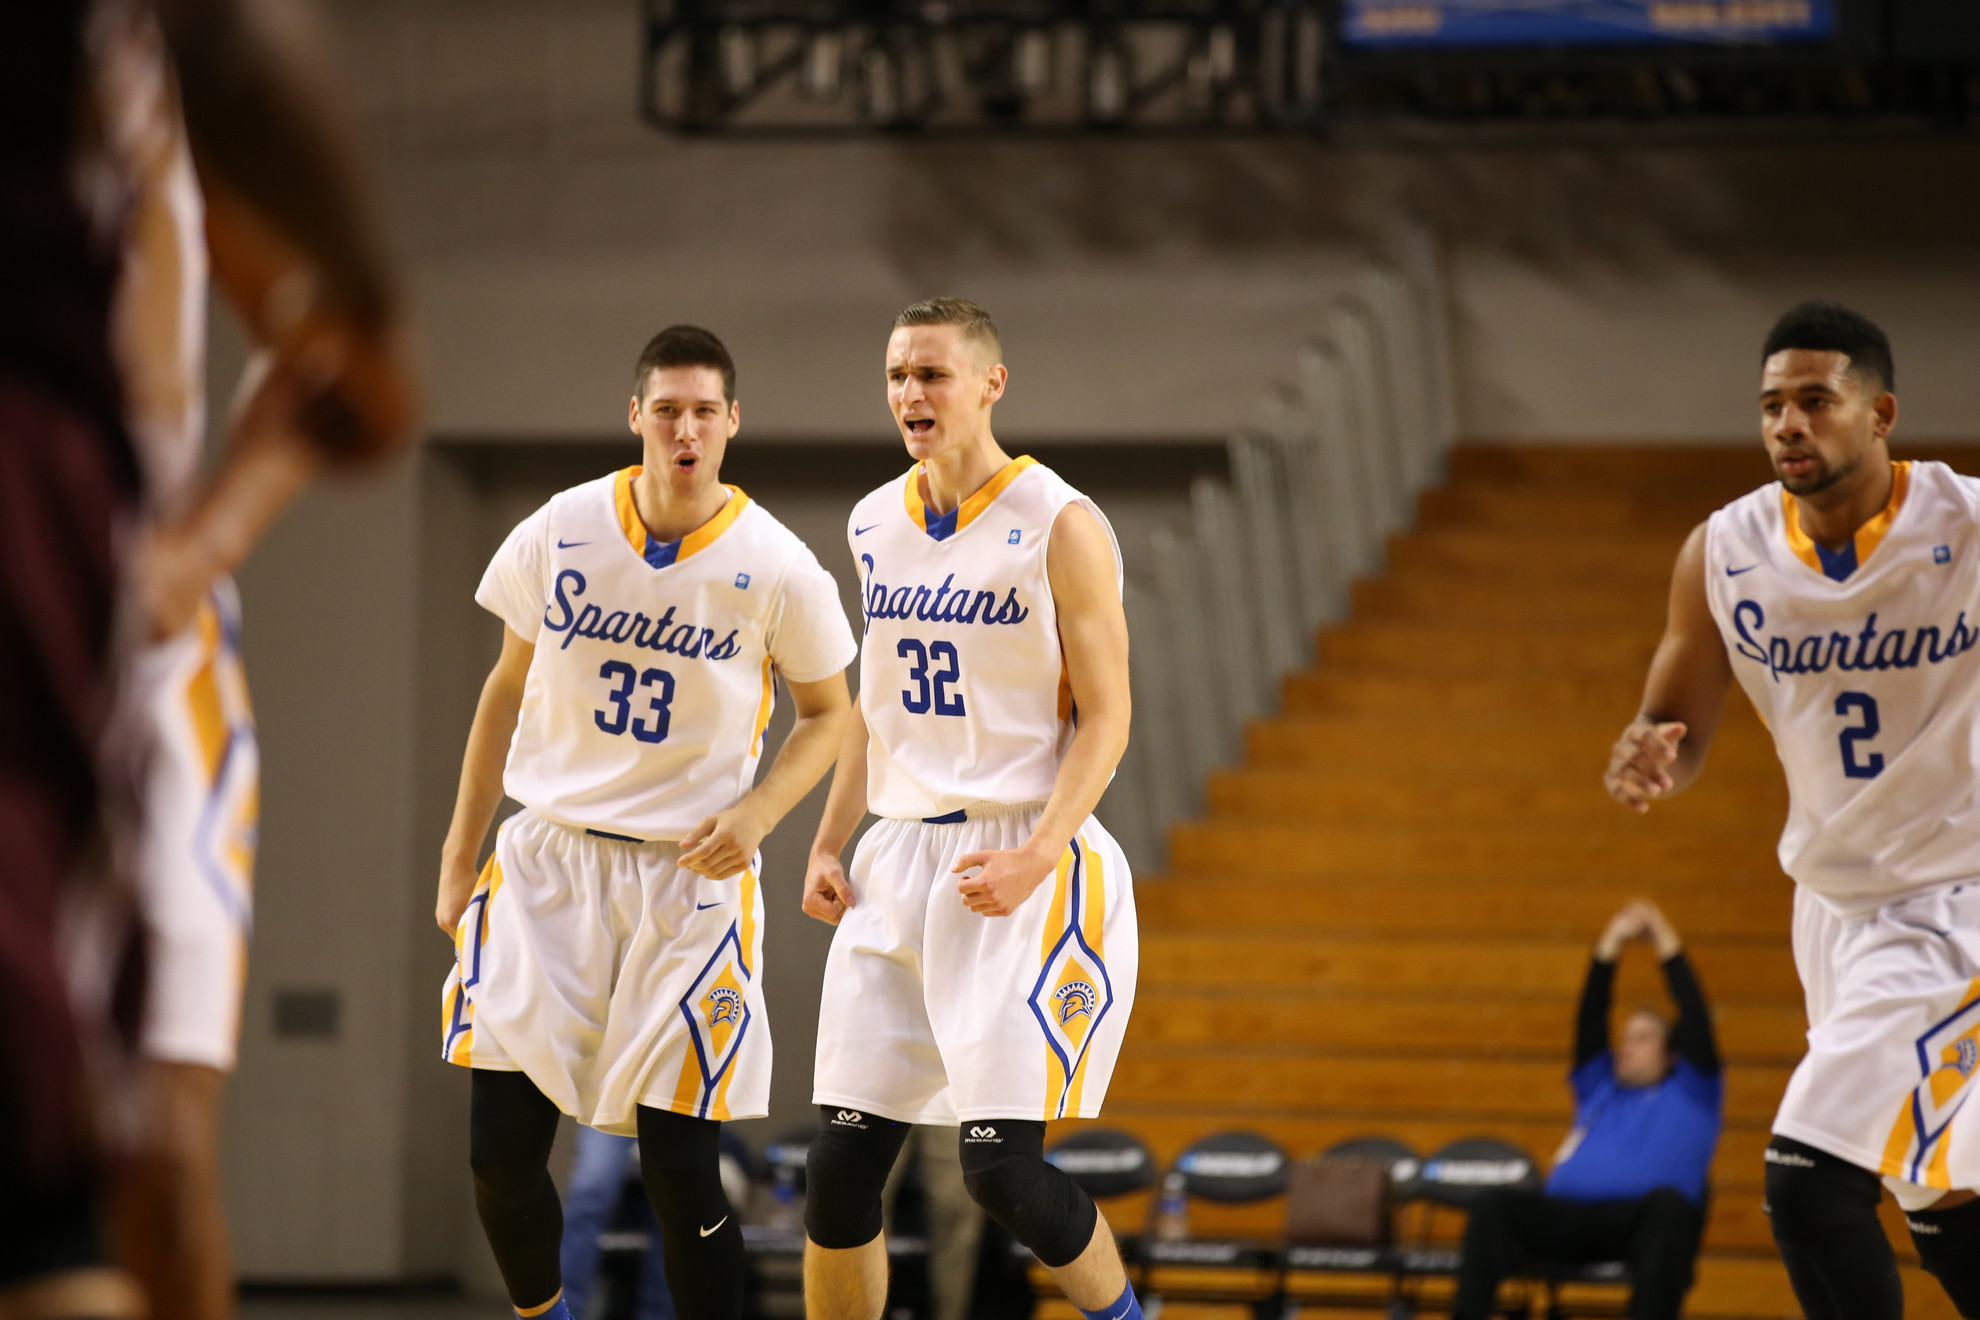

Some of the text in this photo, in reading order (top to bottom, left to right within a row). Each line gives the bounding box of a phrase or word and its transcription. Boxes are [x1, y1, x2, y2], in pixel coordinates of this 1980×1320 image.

[544, 568, 739, 661] Spartans
[1733, 599, 1979, 683] Spartans
[594, 660, 675, 744] 33
[897, 638, 966, 717] 32
[1834, 691, 1885, 779] 2
